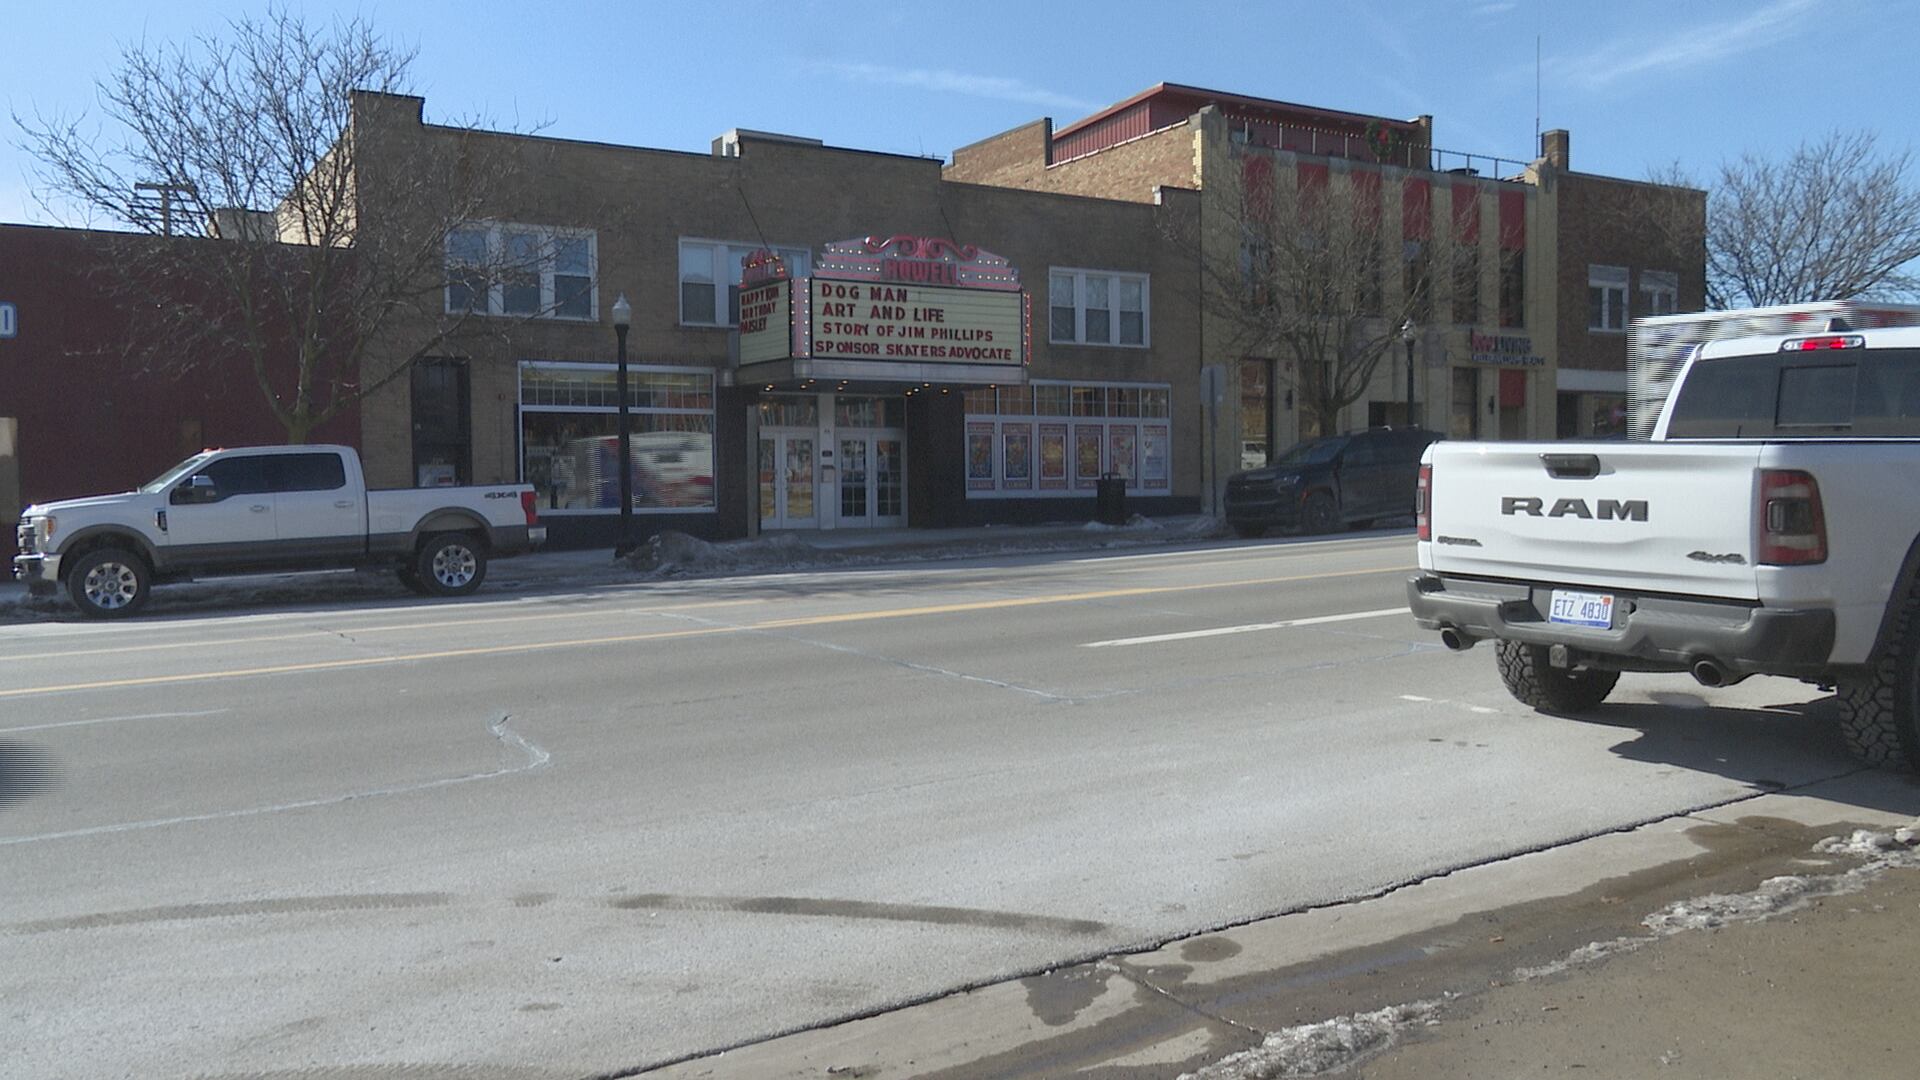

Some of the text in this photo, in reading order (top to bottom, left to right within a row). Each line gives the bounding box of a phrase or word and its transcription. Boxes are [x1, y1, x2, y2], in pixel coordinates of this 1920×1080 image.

[884, 261, 959, 285] HOWELL
[822, 283, 908, 302] DOG MAN
[823, 303, 945, 323] ART AND LIFE
[823, 323, 993, 342] STORY OF JIM PHILLIPS
[815, 340, 1012, 360] SPONSOR SKATERS ADVOCATE
[1502, 496, 1649, 522] RAM
[1553, 599, 1609, 620] ETZ 4830
